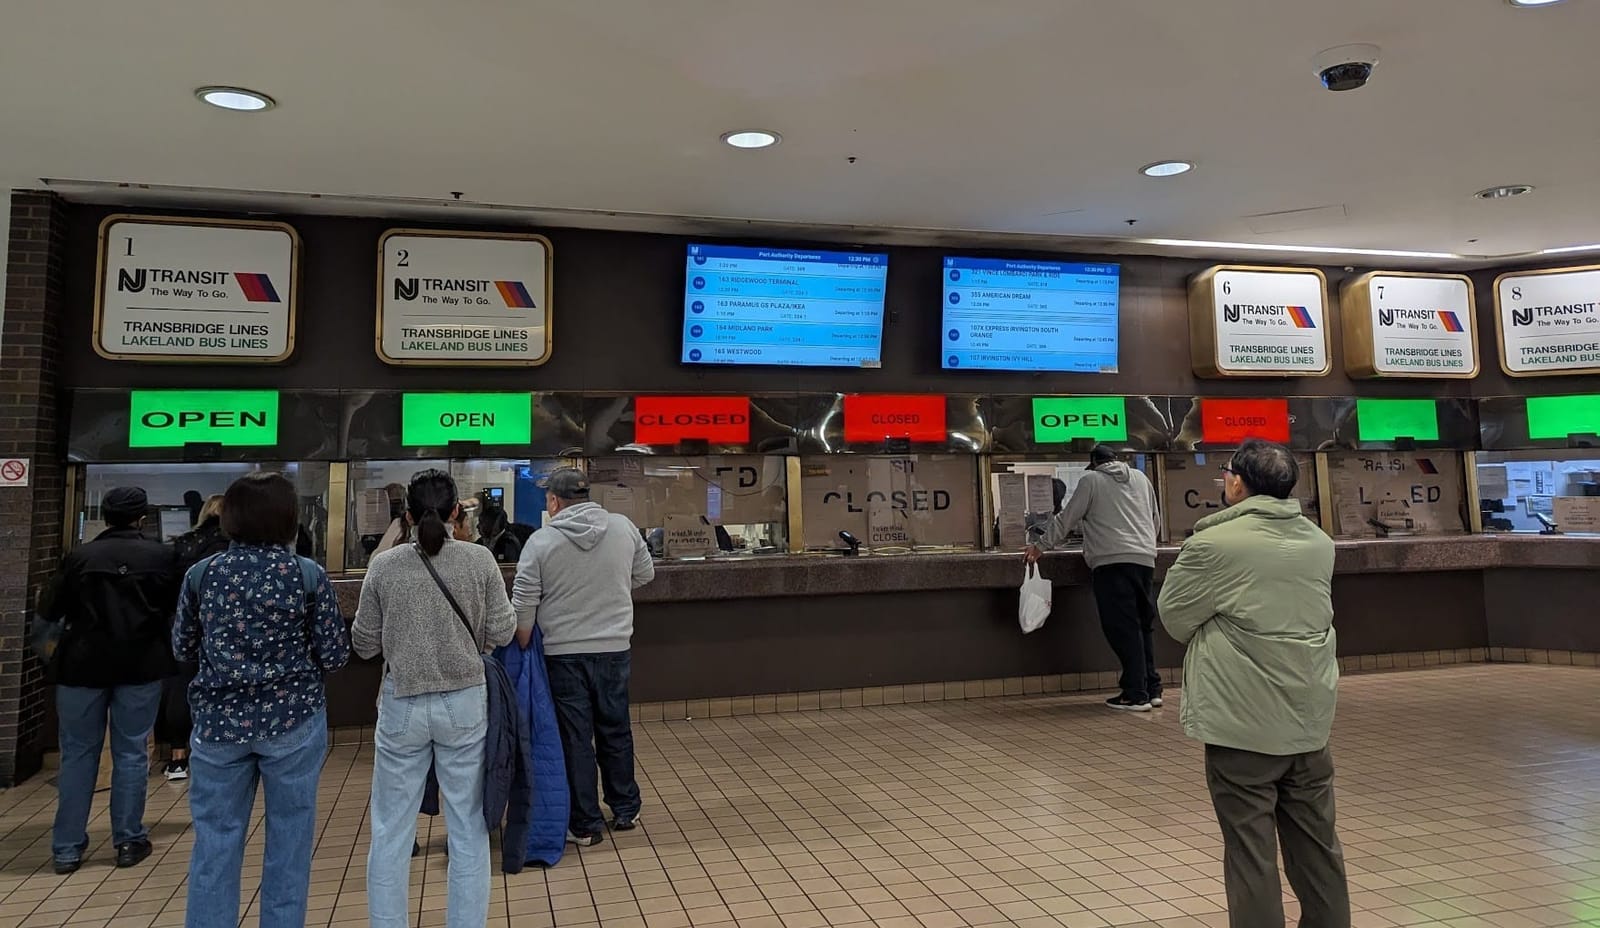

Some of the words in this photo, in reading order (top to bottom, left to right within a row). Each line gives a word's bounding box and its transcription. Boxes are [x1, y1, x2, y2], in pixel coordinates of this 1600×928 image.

[124, 237, 135, 256] 1
[397, 249, 409, 267] 2
[118, 268, 147, 293] NJ
[149, 269, 229, 285] TRANSIT
[150, 288, 169, 296] The
[173, 288, 193, 298] Way
[197, 289, 208, 298] To
[212, 290, 229, 299] Go.
[394, 278, 419, 301] NJ
[422, 279, 490, 292] TRANSIT
[1223, 281, 1231, 295] 6
[1377, 286, 1385, 300] 7
[1512, 287, 1522, 300] 8
[422, 296, 437, 304] The
[442, 296, 459, 306] Way
[463, 297, 473, 305] To
[476, 297, 491, 305] Go.
[1224, 304, 1240, 323] NJ
[1240, 305, 1286, 316] TRANSIT
[1378, 309, 1394, 326] NJ
[1395, 309, 1435, 320] TRANSIT
[1512, 308, 1533, 326] NJ
[1535, 302, 1596, 317] TRANSIT
[124, 321, 224, 334] TRANSBRIDGE
[229, 325, 269, 336] LINES
[401, 328, 490, 339] TRANSBRIDGE
[493, 330, 528, 339] LINES
[121, 335, 194, 347] LAKELAND
[199, 337, 226, 348] BUS
[231, 338, 268, 349] LINES
[401, 341, 465, 351] LAKELAND
[467, 342, 492, 351] BUS
[495, 343, 528, 352] LINES
[1229, 345, 1288, 354] TRANSBRIDGE
[1291, 346, 1314, 354] LINES
[1385, 348, 1439, 356] TRANSBRIDGE
[1441, 349, 1462, 357] LINES
[1520, 343, 1599, 355] TRANSBRIDGE
[1230, 355, 1272, 364] LAKELAND
[1274, 356, 1290, 364] BUS
[1292, 356, 1314, 365] LINES
[1385, 358, 1424, 366] LAKELAND
[1442, 359, 1464, 367] LINES
[1521, 354, 1577, 365] LAKELAND
[141, 410, 267, 428] OPEN
[439, 412, 495, 428] OPEN
[638, 414, 746, 426] CLOSED
[871, 414, 920, 425] CLOSED
[1040, 413, 1119, 428] OPEN
[1225, 416, 1266, 427] CLOSED
